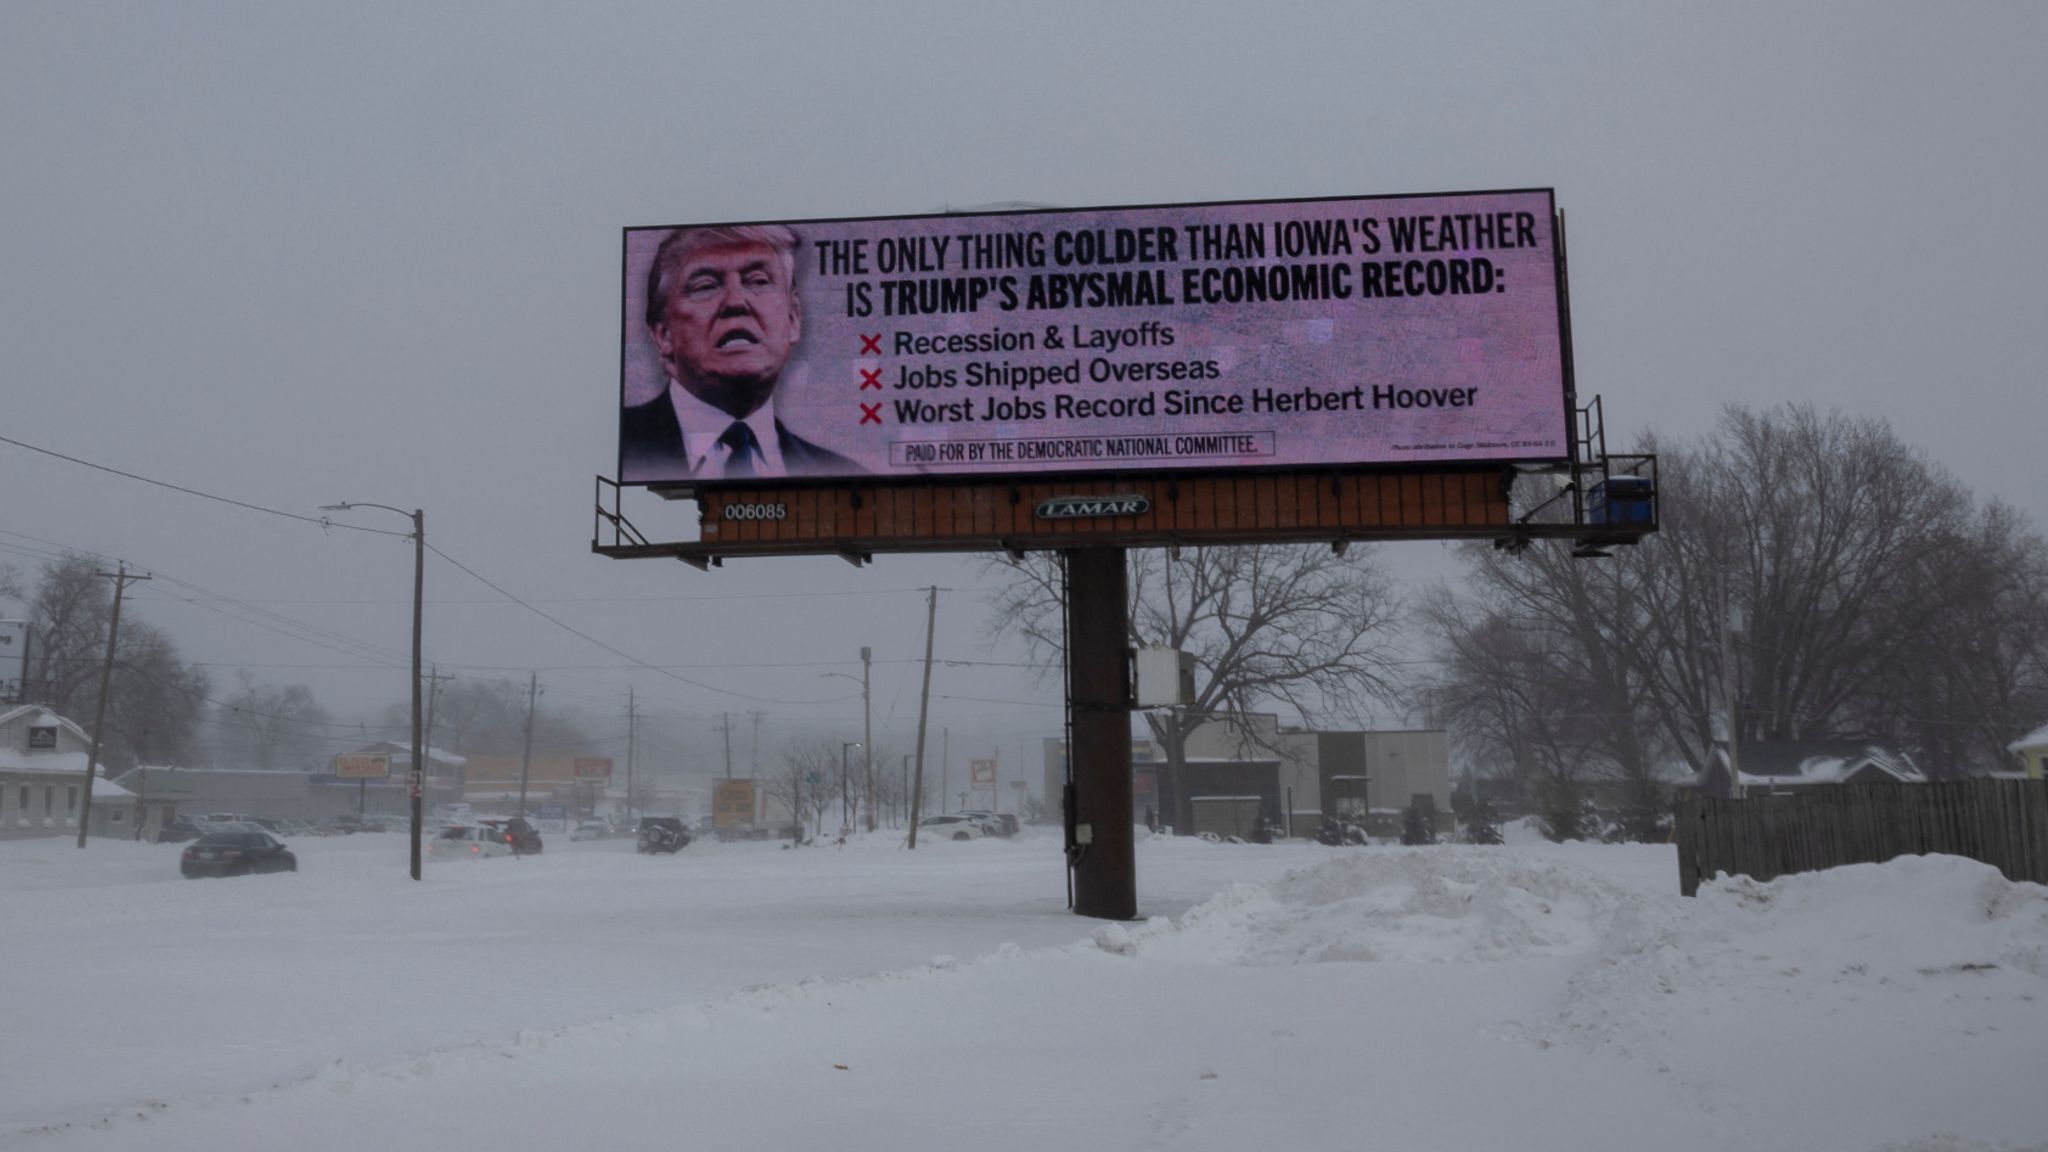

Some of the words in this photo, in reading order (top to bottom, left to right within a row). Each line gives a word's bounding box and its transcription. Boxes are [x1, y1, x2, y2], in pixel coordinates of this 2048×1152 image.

[814, 238, 869, 276] THE
[877, 235, 950, 273] ONLY
[956, 231, 1046, 270] THING
[1053, 226, 1178, 266] COLDER
[1184, 222, 1265, 261] THAN
[1274, 217, 1381, 258] IOWA'S
[1387, 211, 1537, 253] WEATHER
[846, 281, 873, 318] IS
[879, 274, 1019, 316] TRUMP'S
[1026, 269, 1175, 310] ABYSMAL
[1182, 262, 1353, 305] ECONOMIC
[1361, 257, 1505, 298] RECORD:
[894, 328, 1035, 356] Recession
[1042, 325, 1065, 350] &
[1073, 321, 1176, 353] Layoffs
[893, 364, 958, 390] Jobs
[965, 359, 1080, 391] Shipped
[1088, 358, 1221, 384] Overseas
[893, 398, 975, 424] Worst
[980, 395, 1047, 422] Jobs
[1055, 391, 1156, 419] Record
[1163, 389, 1245, 416] Since
[1252, 385, 1365, 413] Herbert
[1372, 383, 1479, 410] Hoover
[905, 445, 936, 463] PAID
[938, 444, 965, 461] FOR
[968, 443, 986, 460] BY
[988, 442, 1014, 460] THE
[1017, 439, 1103, 459] DEMOCRATIC
[1106, 437, 1172, 457] NATIONAL
[1175, 434, 1258, 455] COMMITTEE.
[725, 503, 786, 519] 006085
[1045, 501, 1139, 516] LAMAR
